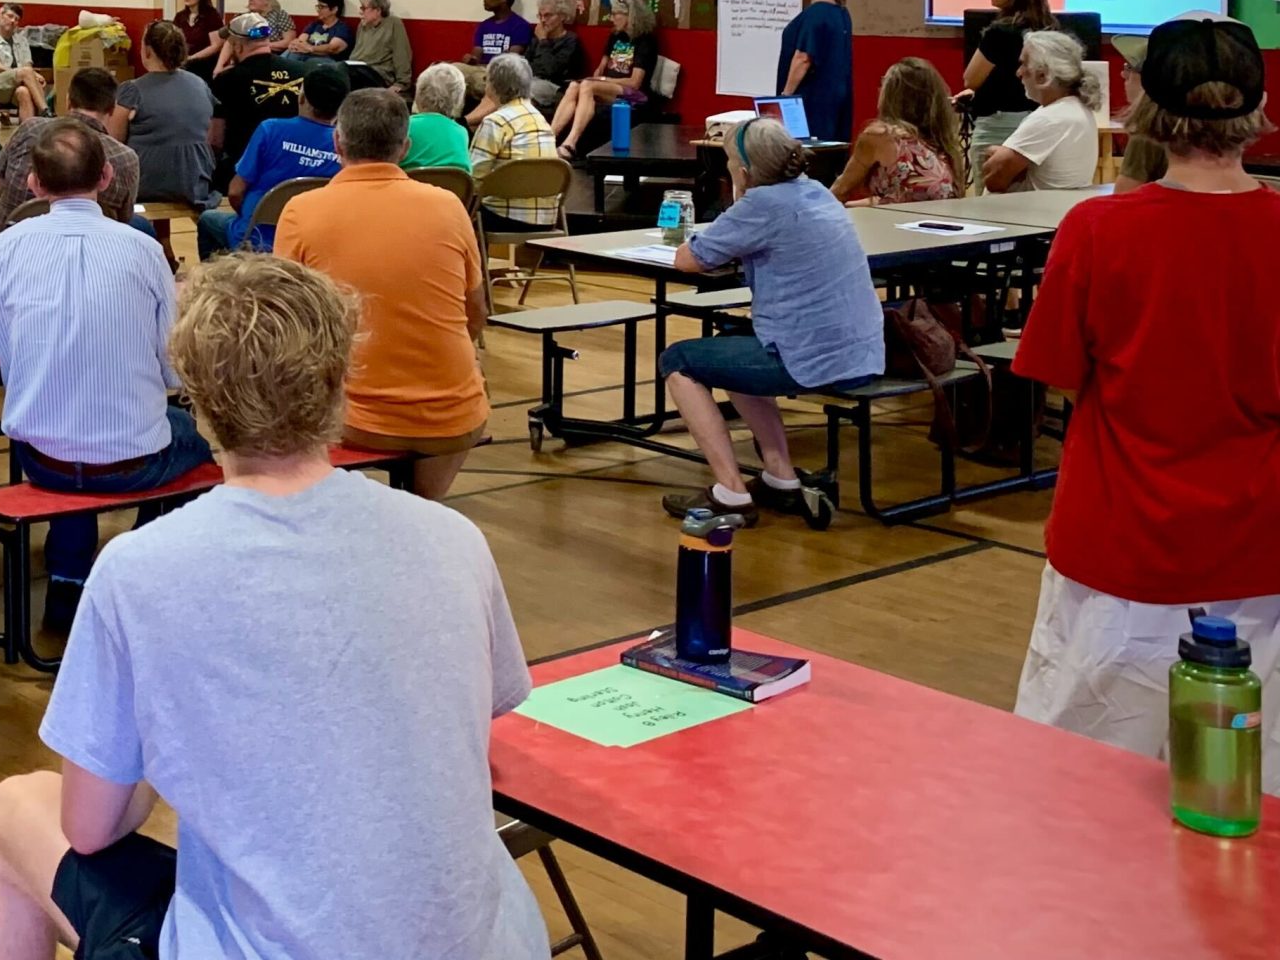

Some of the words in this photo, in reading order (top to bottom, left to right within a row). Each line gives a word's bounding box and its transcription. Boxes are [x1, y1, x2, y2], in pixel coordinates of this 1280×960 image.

[271, 70, 290, 80] 502
[250, 86, 256, 95] 3
[281, 94, 290, 104] A
